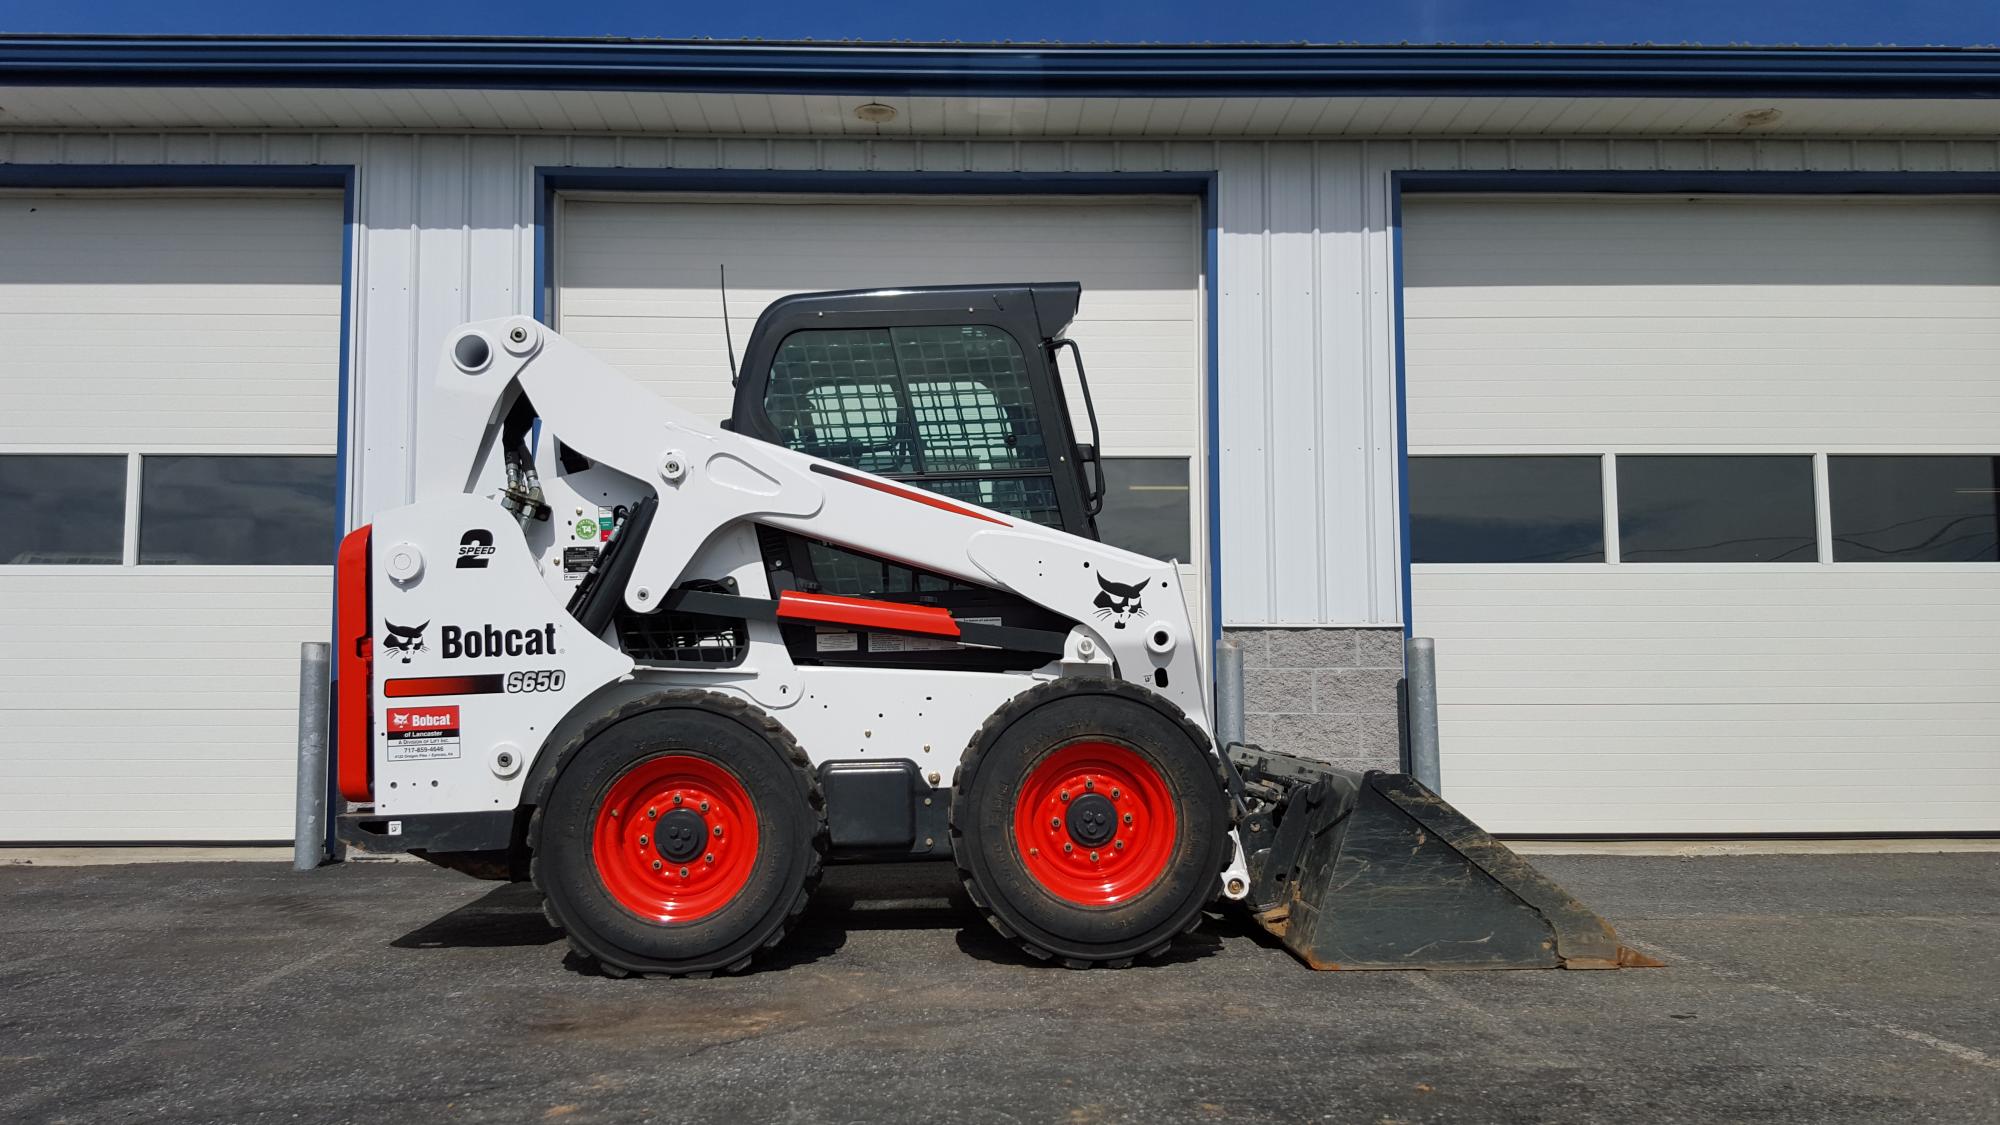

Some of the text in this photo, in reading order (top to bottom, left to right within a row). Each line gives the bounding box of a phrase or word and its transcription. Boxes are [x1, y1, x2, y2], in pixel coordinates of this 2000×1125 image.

[456, 528, 494, 568] 2
[458, 546, 496, 555] SPEED
[442, 622, 556, 659] Bobcat
[506, 670, 566, 694] S650
[412, 714, 450, 726] Bobcat
